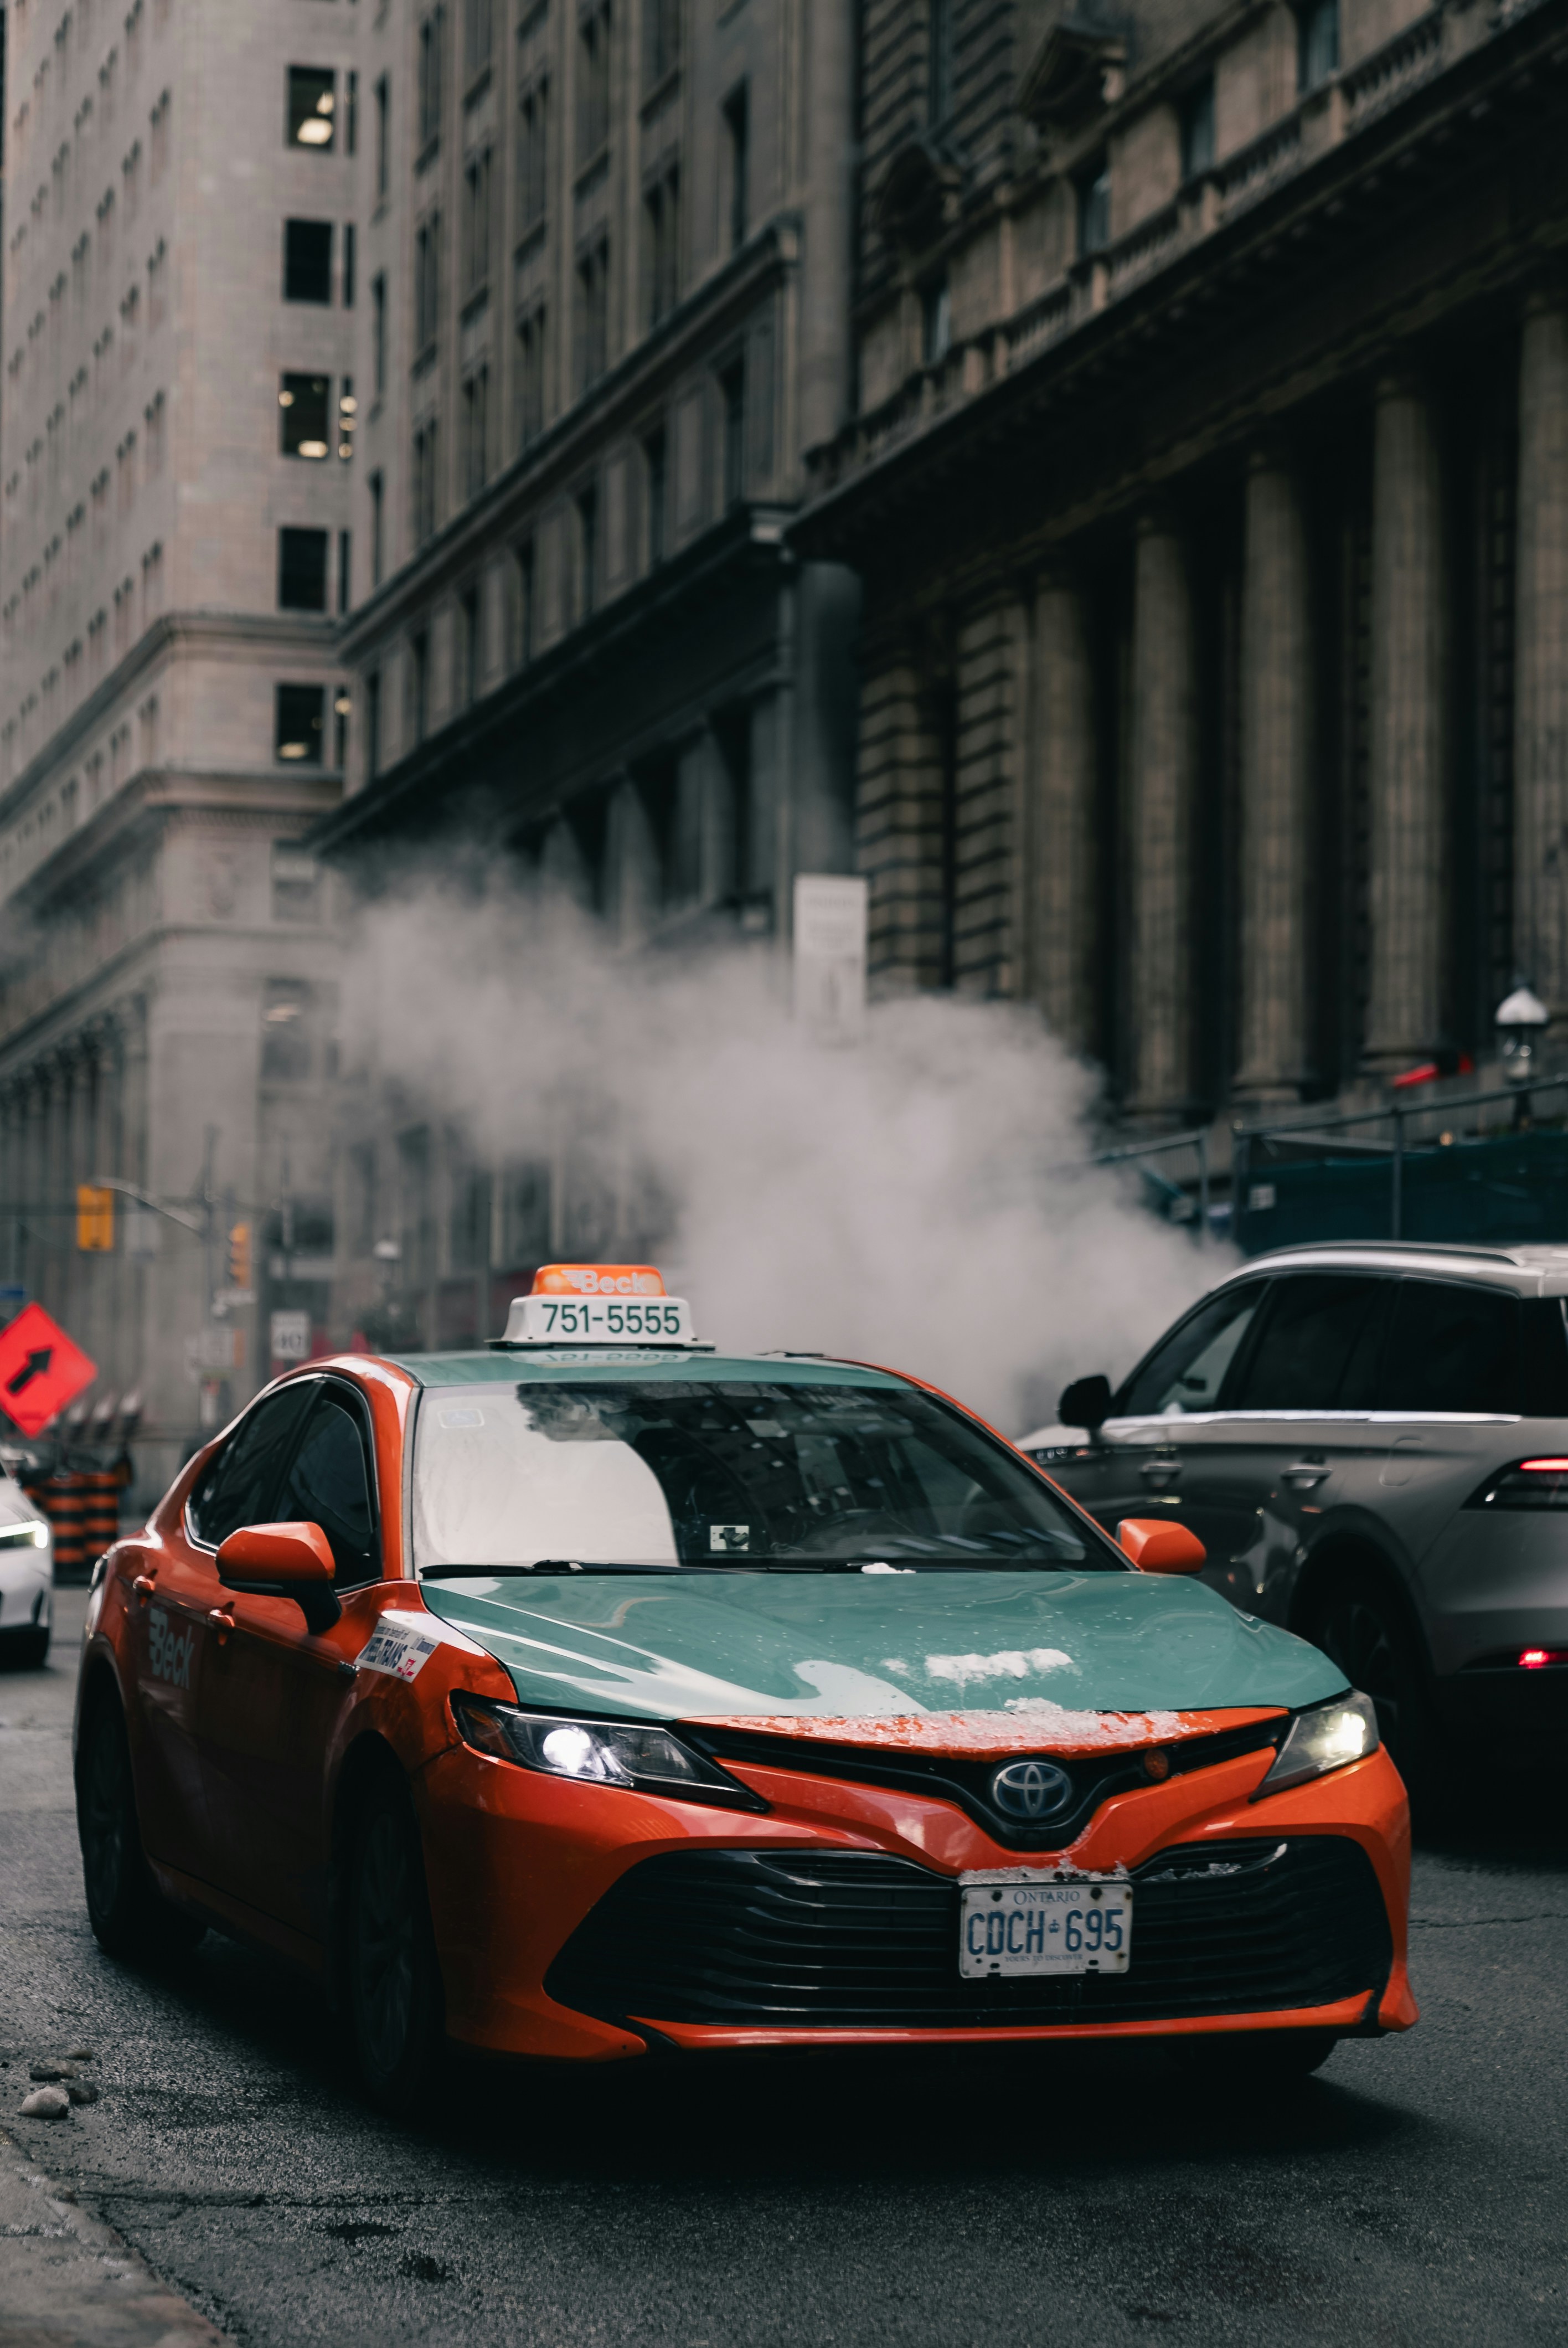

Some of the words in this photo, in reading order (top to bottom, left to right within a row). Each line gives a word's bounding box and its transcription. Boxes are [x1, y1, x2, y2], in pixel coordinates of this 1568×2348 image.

[564, 1270, 647, 1294] Beck
[541, 1304, 681, 1335] 751-5555
[149, 1607, 195, 1690] Beck
[1014, 1891, 1080, 1905] ONTARIO
[968, 1911, 1045, 1955] CDCH
[1065, 1909, 1124, 1952] 695
